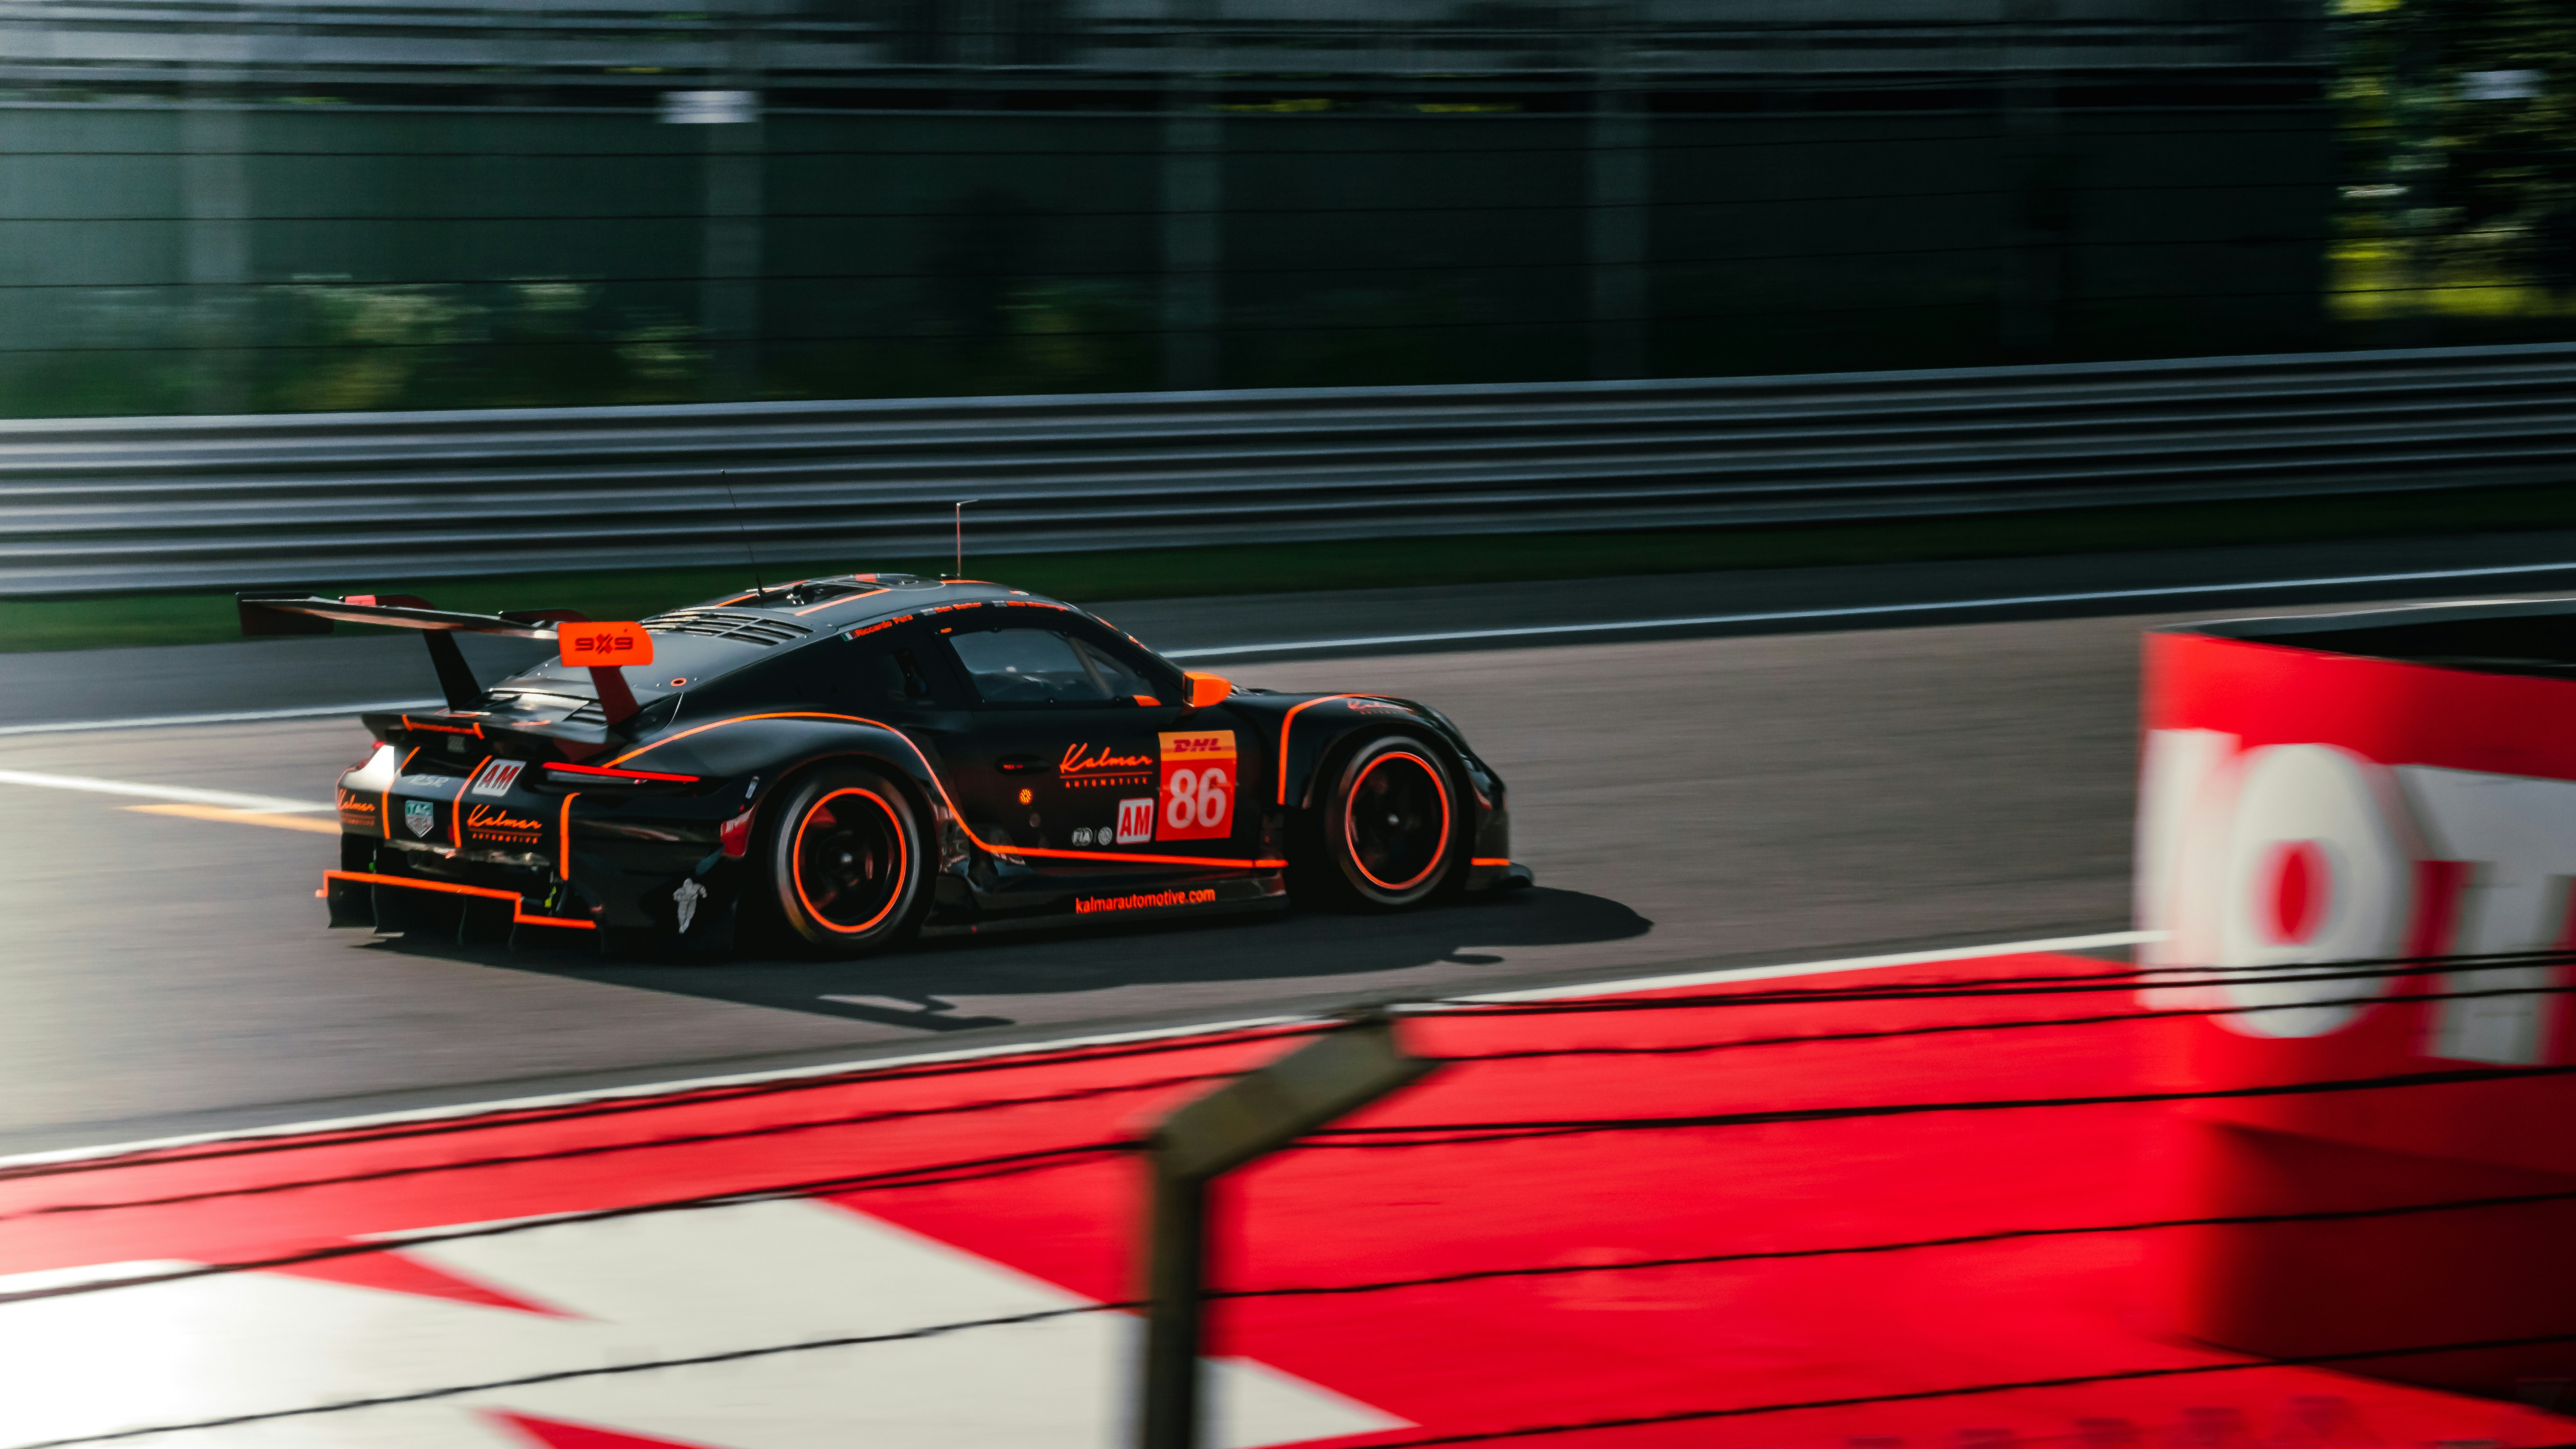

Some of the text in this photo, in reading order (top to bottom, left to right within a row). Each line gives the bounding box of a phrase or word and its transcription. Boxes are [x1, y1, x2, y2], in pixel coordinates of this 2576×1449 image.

[1173, 738, 1222, 752] DHL
[1059, 743, 1153, 774] Kalmar
[478, 764, 521, 789] AM
[1167, 767, 1227, 829] 86
[467, 804, 542, 829] Kalmar
[1119, 805, 1151, 837] AM
[1076, 889, 1216, 914] kalmarautomotive.com
